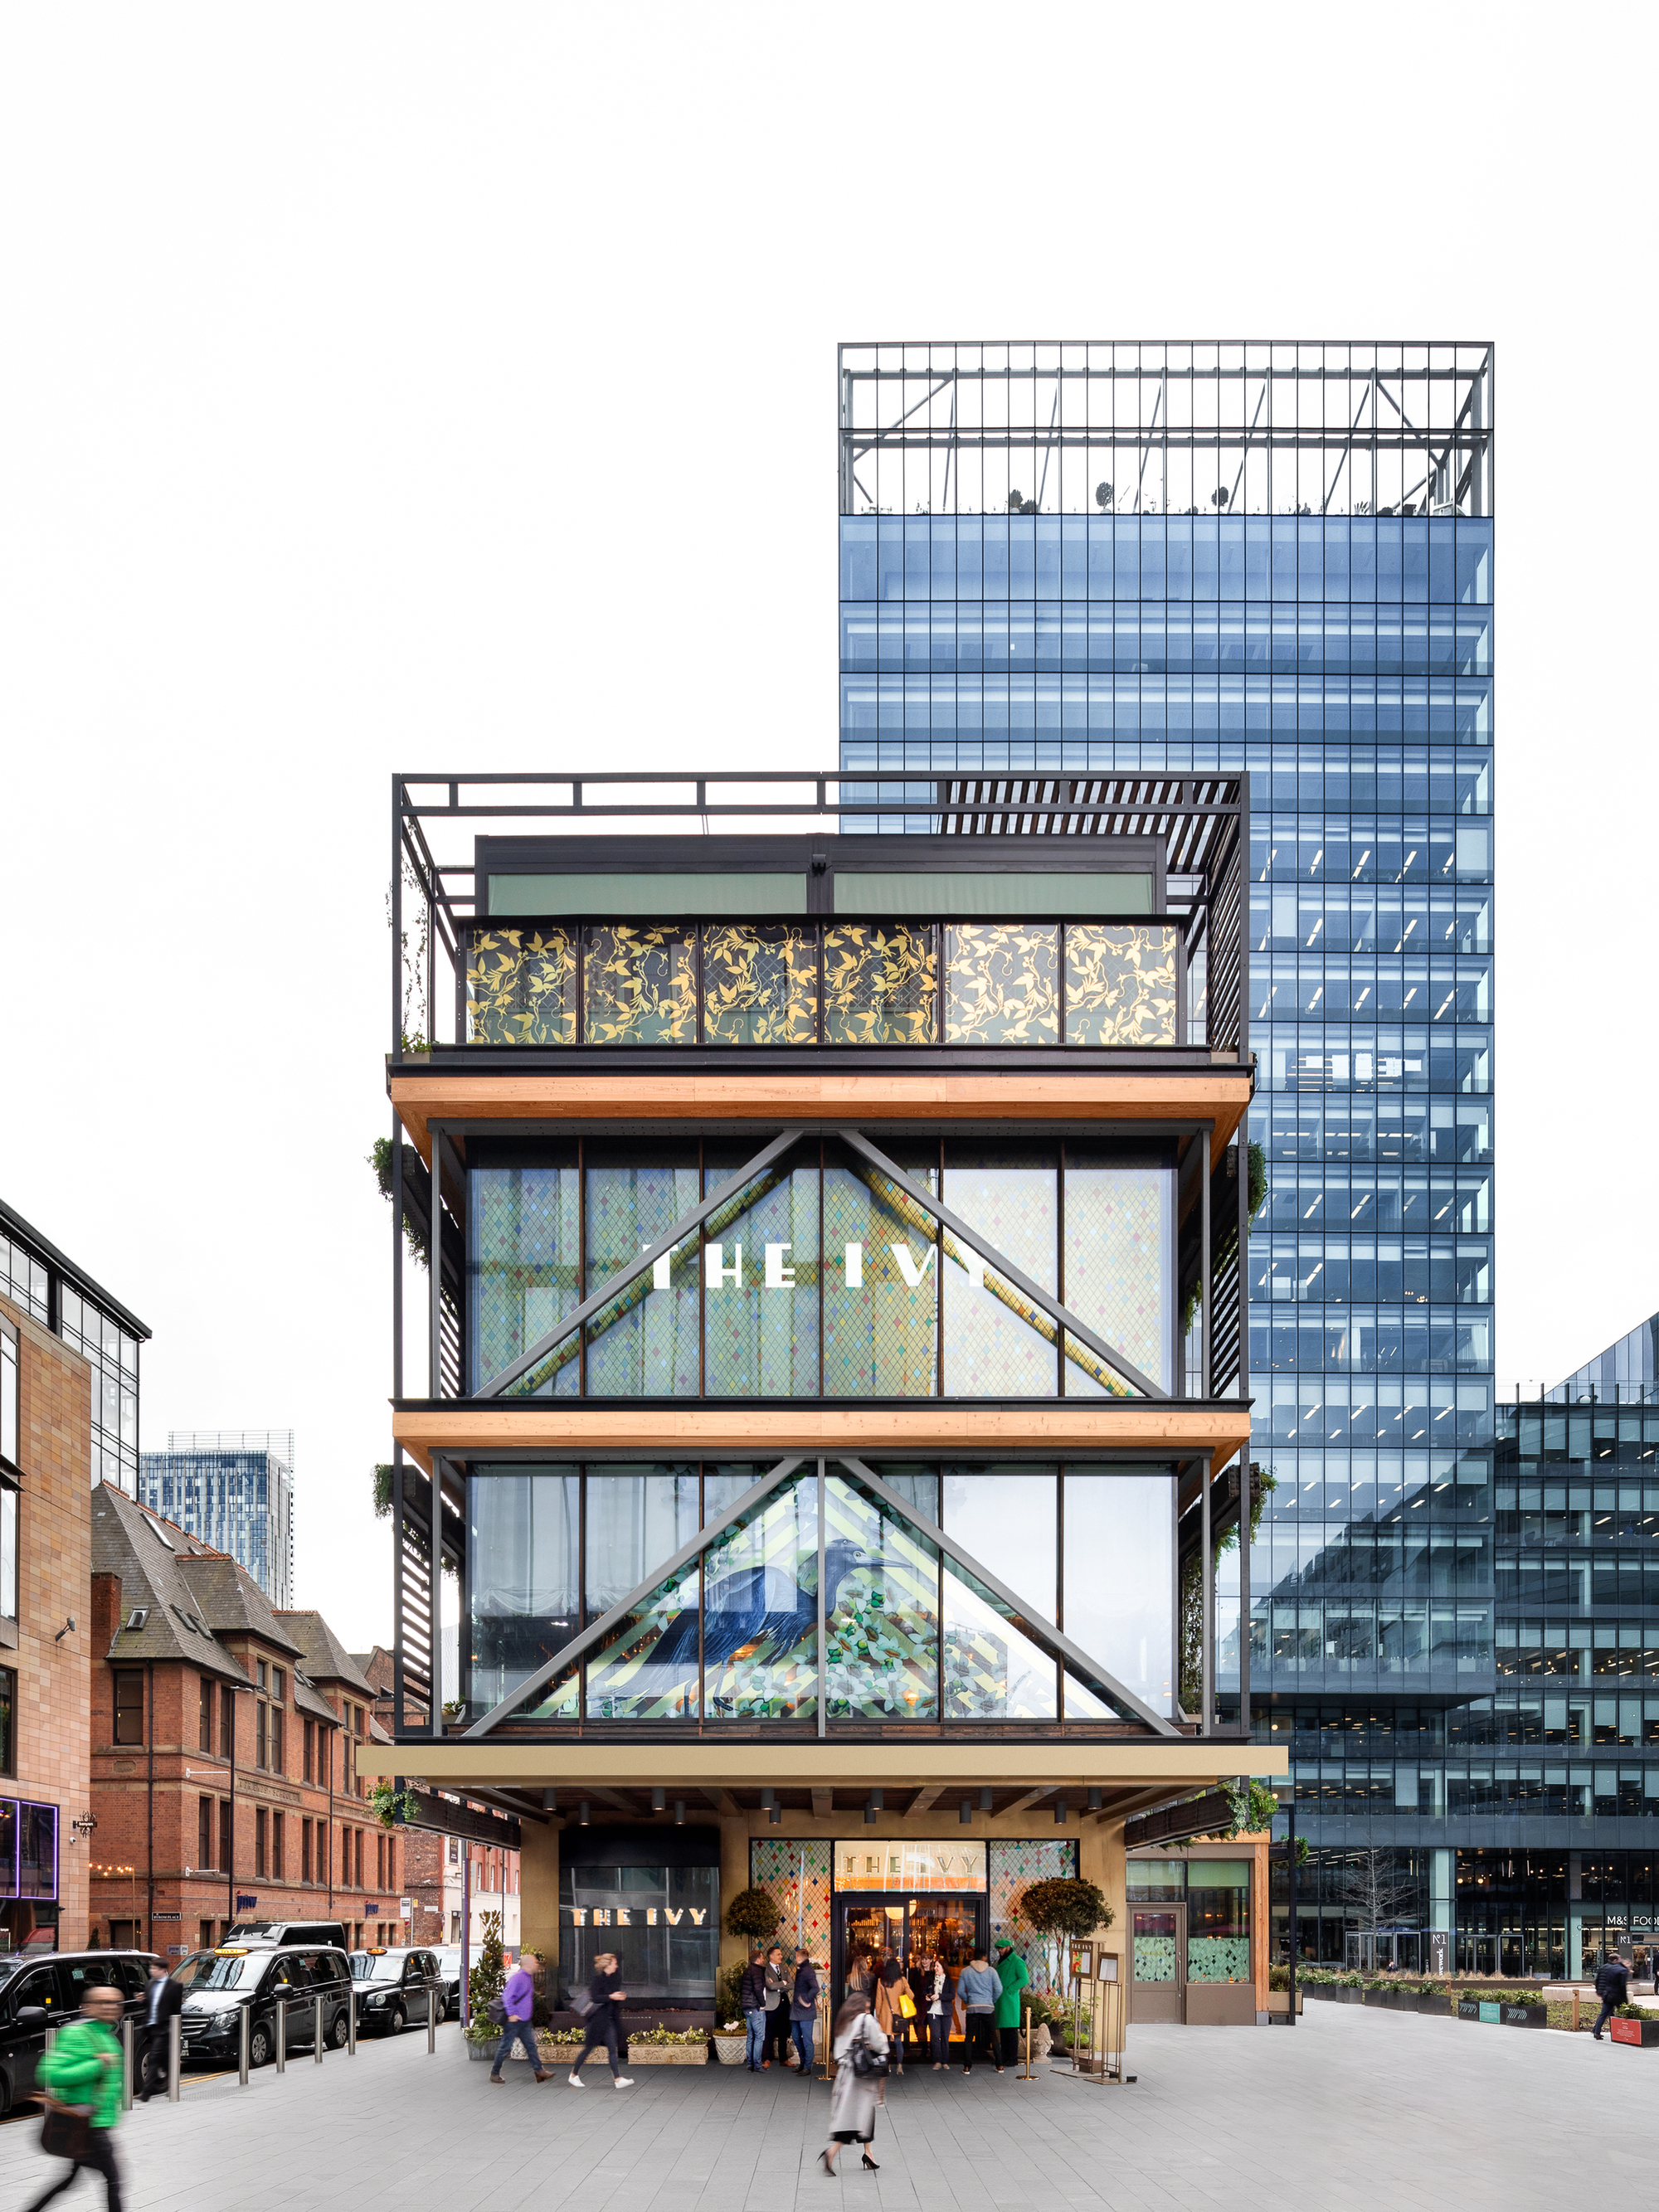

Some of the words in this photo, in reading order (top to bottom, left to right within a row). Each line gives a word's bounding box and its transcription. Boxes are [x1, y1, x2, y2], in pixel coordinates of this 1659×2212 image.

[642, 1243, 795, 1289] THE
[845, 1242, 998, 1287] IVY
[843, 1856, 901, 1873] THE
[920, 1856, 977, 1873] IVY
[236, 1890, 257, 1915] jmw
[365, 1899, 379, 1918] jmw
[571, 1908, 631, 1926] THE
[646, 1908, 707, 1925] IVY
[1607, 1916, 1627, 1925] M&S
[1633, 1916, 1659, 1925] FOO
[1436, 1947, 1444, 1976] wework
